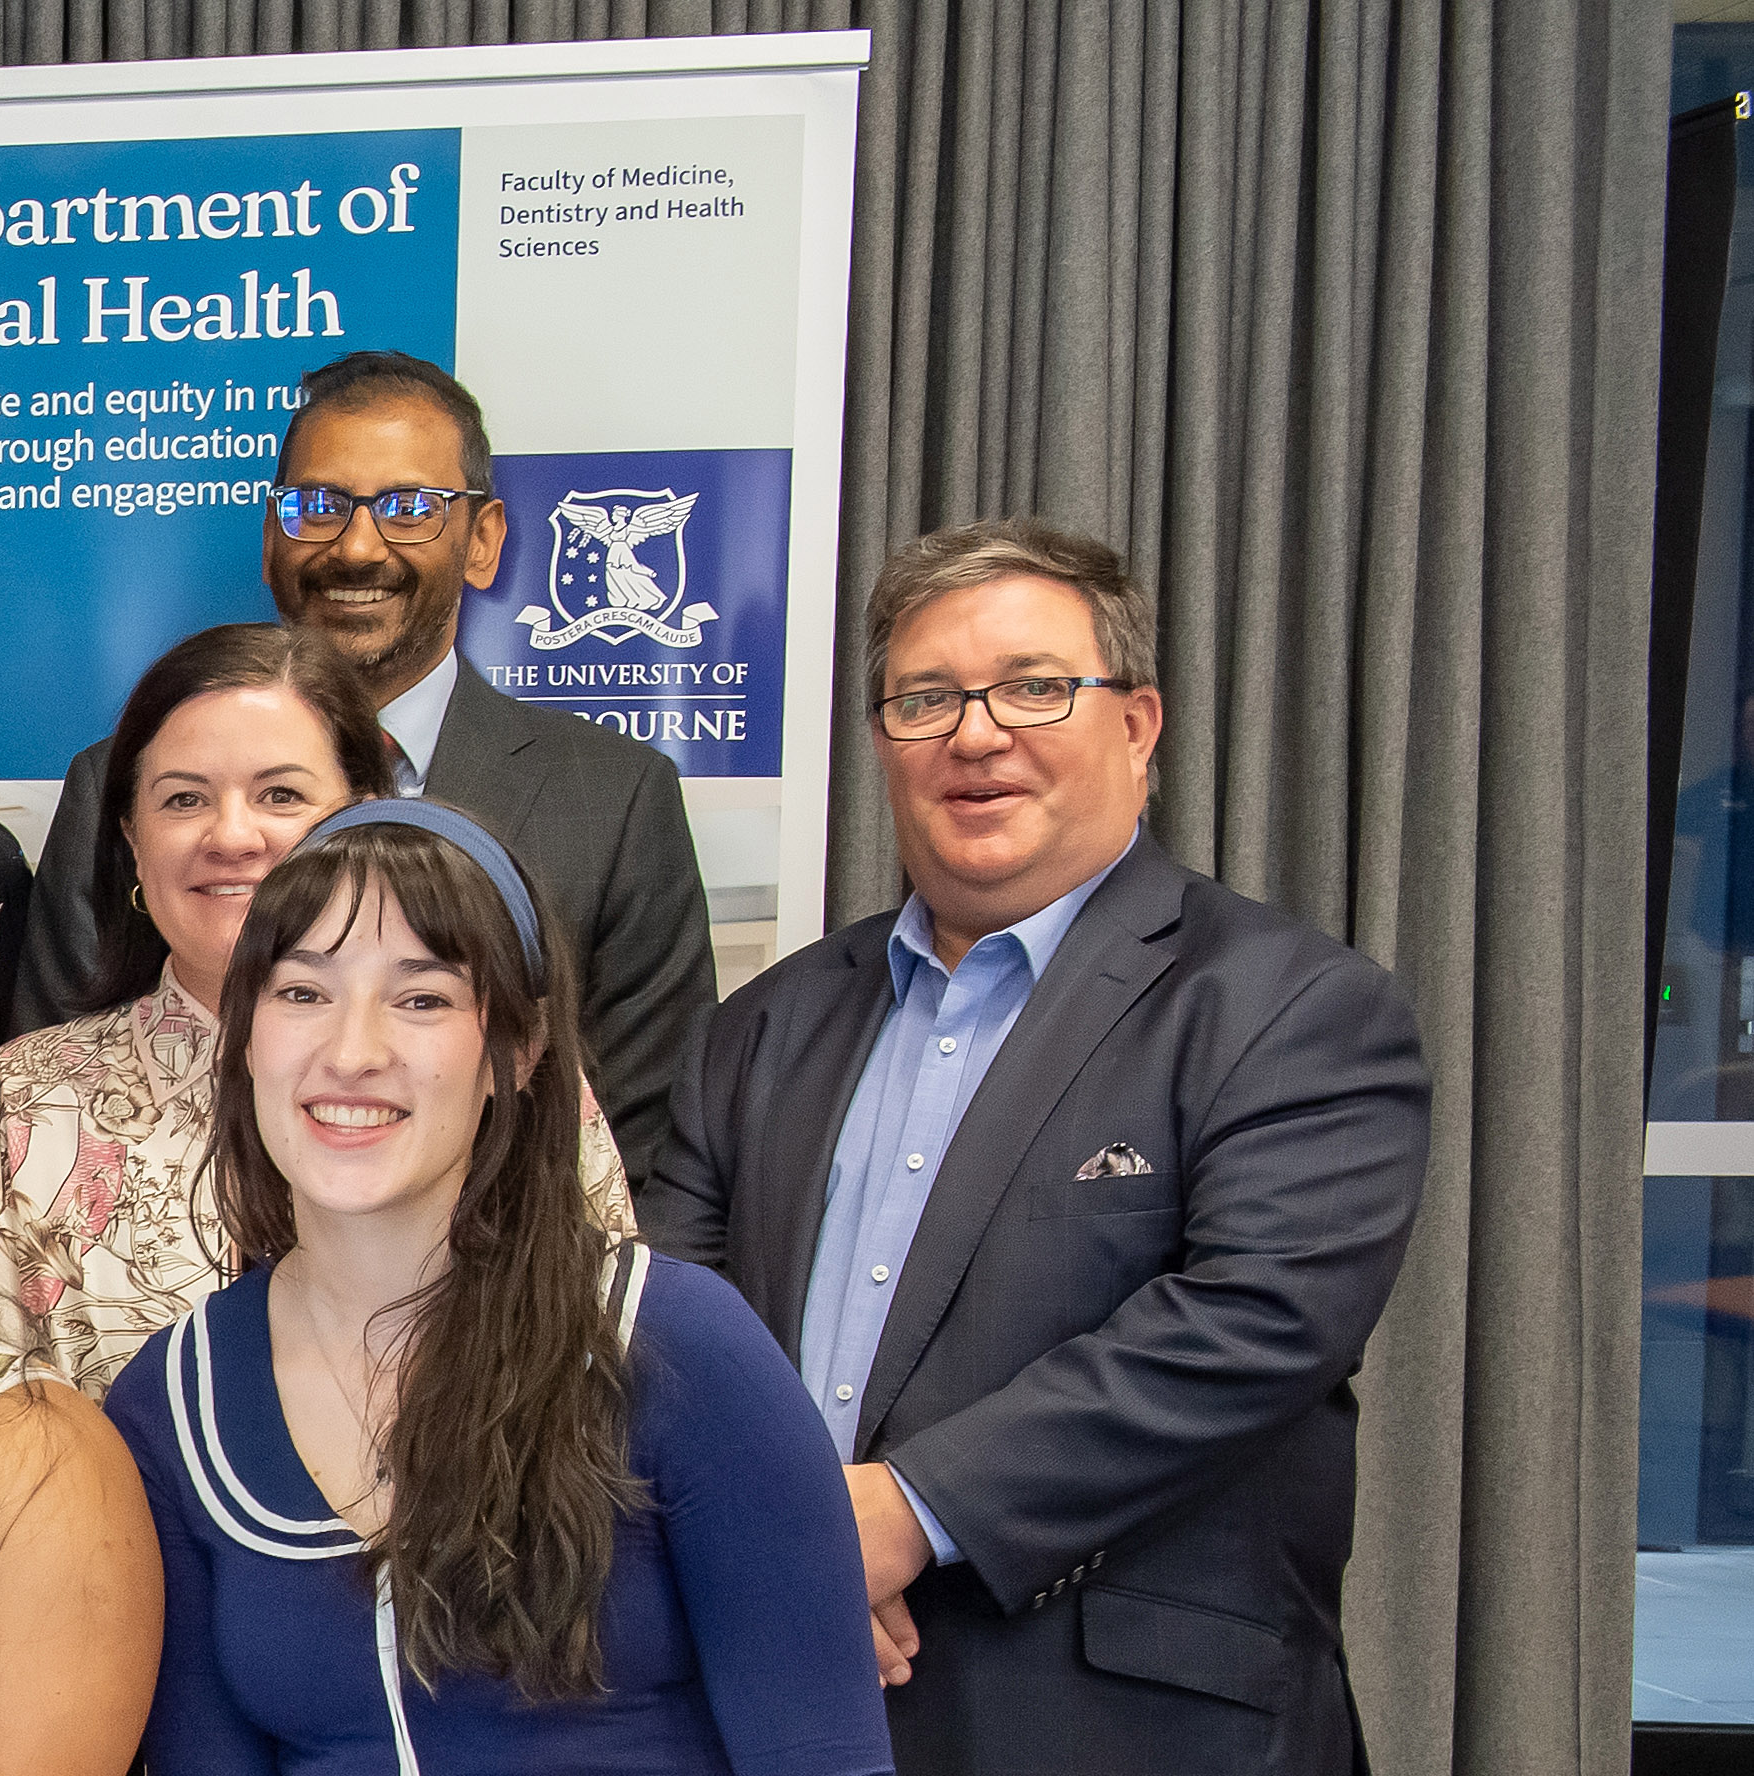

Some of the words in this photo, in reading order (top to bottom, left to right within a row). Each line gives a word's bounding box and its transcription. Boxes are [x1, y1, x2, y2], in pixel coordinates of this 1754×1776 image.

[501, 169, 585, 195] Faculty
[592, 168, 616, 188] of
[622, 165, 734, 188] Medicine,
[337, 163, 420, 235] of
[500, 203, 608, 227] Dentistry
[615, 199, 659, 221] and
[667, 196, 744, 219] Health
[499, 237, 600, 258] Sciences
[82, 267, 345, 344] Health
[30, 383, 94, 417] and
[102, 381, 215, 423] equity
[225, 379, 256, 412] in
[104, 426, 277, 461] education
[72, 480, 273, 517] engagemen
[535, 620, 592, 646] POSTERA
[593, 611, 654, 632] CRESCAM
[654, 627, 699, 644] LAUDE
[486, 665, 539, 687] THE
[548, 663, 710, 686] UNIVERSITY
[712, 663, 749, 685] OF
[573, 710, 747, 742] OURNE
